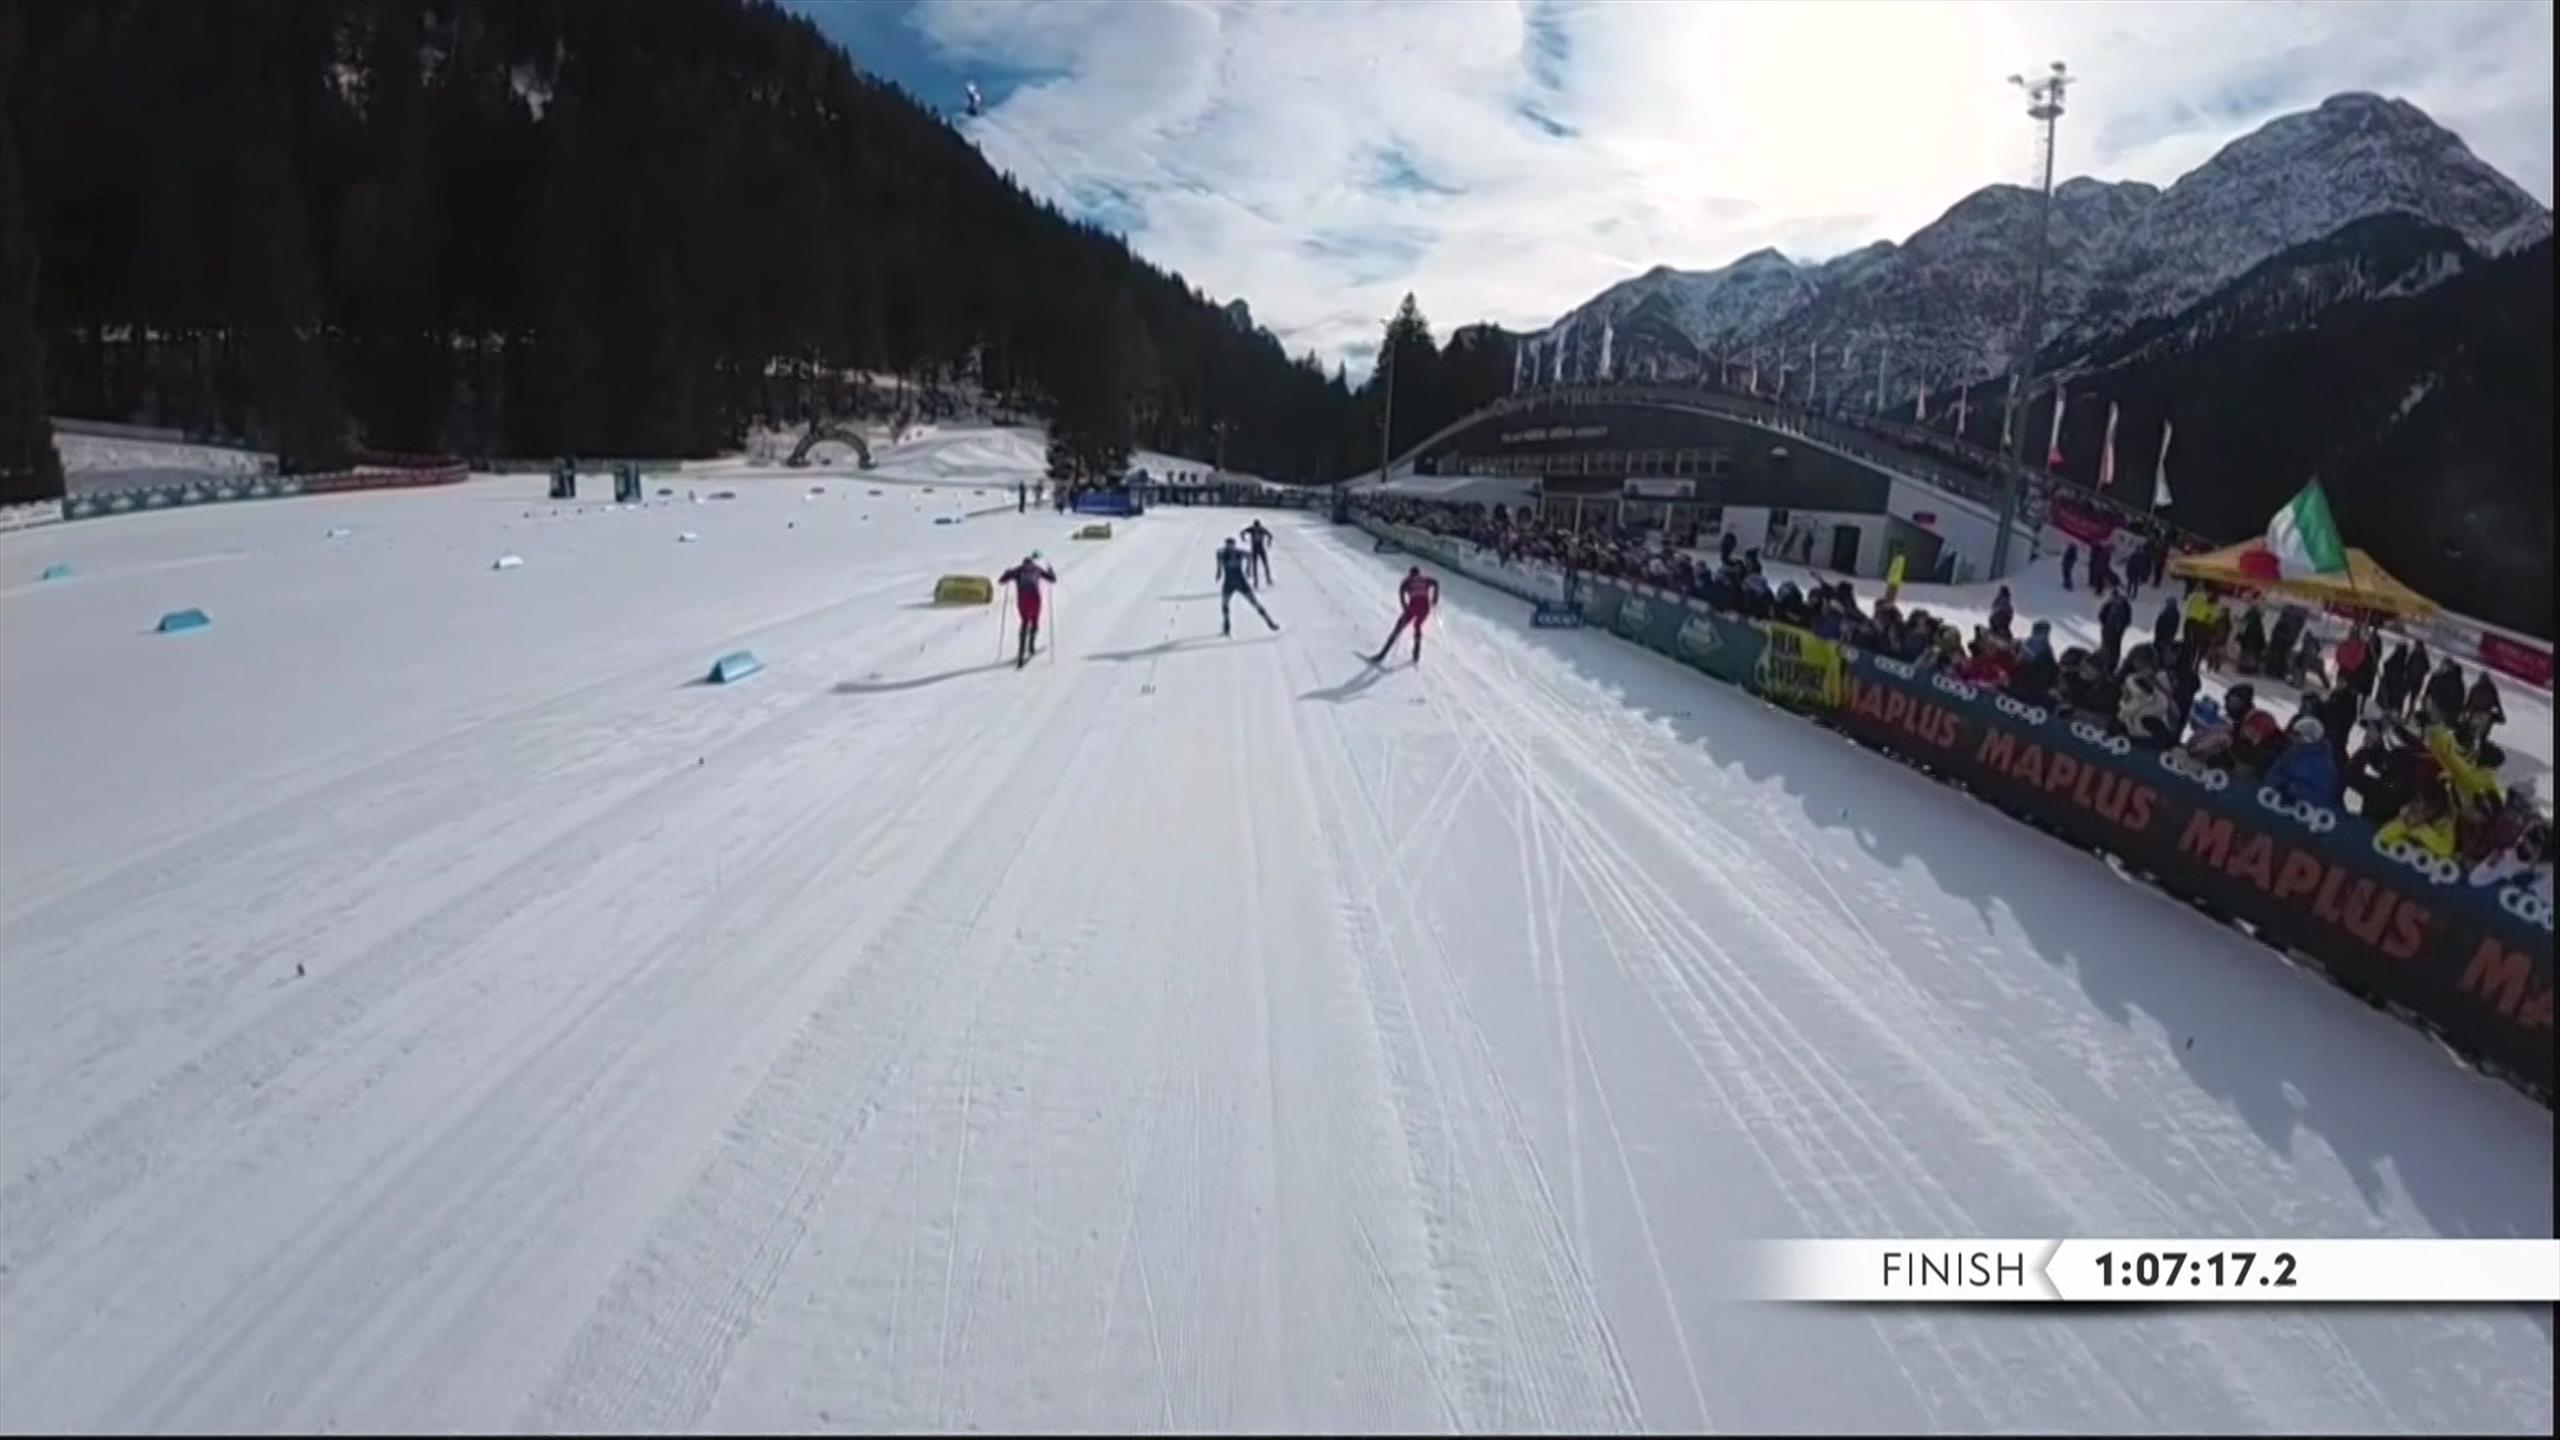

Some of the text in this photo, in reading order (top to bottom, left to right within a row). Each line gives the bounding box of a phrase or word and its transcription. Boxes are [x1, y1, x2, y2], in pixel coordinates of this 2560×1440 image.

[1873, 654, 1915, 679] coop
[1995, 693, 2048, 726] coop
[2372, 831, 2460, 885] coop
[1976, 726, 2158, 832] MAPLUS
[2177, 808, 2432, 960] MAPLUS
